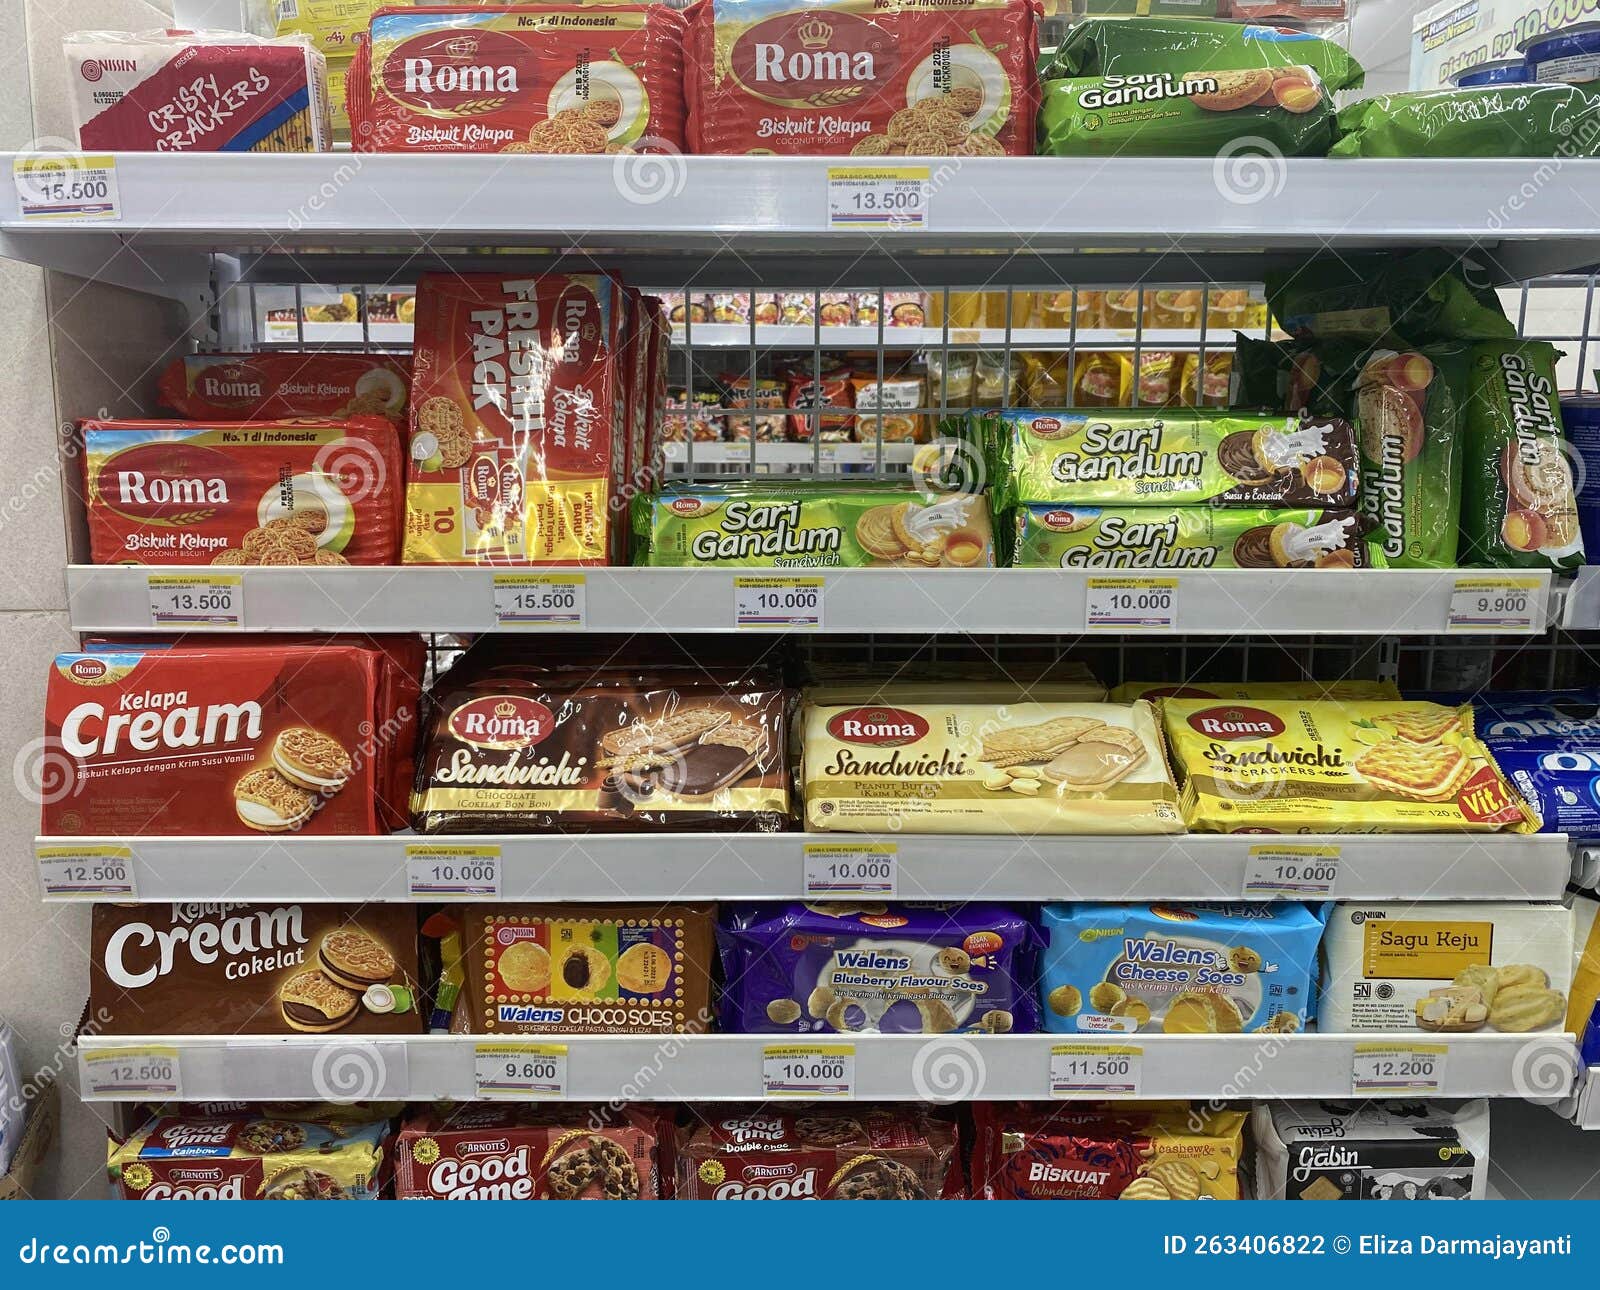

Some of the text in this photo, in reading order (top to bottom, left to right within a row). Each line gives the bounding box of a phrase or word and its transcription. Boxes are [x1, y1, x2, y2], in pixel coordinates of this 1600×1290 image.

[548, 16, 559, 26] di
[560, 16, 617, 27] Indonesia
[99, 59, 137, 72] NISSIN
[755, 43, 876, 82] Roma
[933, 42, 942, 89] FEB 2023
[1439, 32, 1513, 84] Diskon Rp
[405, 58, 519, 93] Roma
[1078, 77, 1218, 109] Gandum
[156, 67, 270, 151] CRACKERS
[406, 125, 514, 144] Biskuit Kelapa
[757, 117, 872, 138] Biskuit Kelapa
[775, 136, 846, 146] COCONUT BISCUIT
[41, 182, 108, 200] 15.500
[853, 192, 919, 209] 13.500
[564, 301, 586, 363] Roma
[470, 309, 508, 411] PACK
[502, 279, 546, 431] FRESH
[204, 378, 350, 397] Roma Biskuit Kelapa
[550, 385, 573, 447] Kelapa
[1501, 353, 1541, 466] Gandum
[1528, 372, 1561, 445] Sari
[1035, 422, 1058, 430] Roma
[222, 432, 317, 442] No. 1 di Indonesia
[1080, 421, 1164, 454] Sari
[1288, 440, 1303, 449] milk
[1051, 442, 1203, 483] Gandum
[117, 471, 230, 504] Roma
[477, 465, 489, 500] Roma
[1135, 478, 1203, 494] Sandwich
[1224, 490, 1282, 500] Susu Cokelat
[1382, 435, 1405, 559] Gandum
[676, 501, 698, 509] Roma
[434, 506, 455, 533] 10
[573, 503, 582, 537] BARU!
[720, 500, 802, 533] Sari
[928, 513, 943, 521] milk
[1048, 514, 1071, 523] Roma
[692, 520, 842, 560] Gandum
[1093, 515, 1178, 549] Sari
[1308, 535, 1323, 544] milk
[125, 534, 228, 551] Biskuit Kelapa
[774, 552, 841, 567] Sandwich
[1060, 537, 1219, 568] Gandum
[172, 594, 231, 609] 13.500
[514, 594, 574, 608] 15.500
[758, 594, 817, 608] 10.000
[1110, 595, 1171, 609] 10.000
[1477, 598, 1526, 612] 9.900
[75, 664, 103, 675] Roma
[120, 691, 188, 713] Kelapa
[60, 700, 263, 758] Cream
[465, 713, 540, 737] Roma
[843, 720, 917, 737] Roma
[1201, 718, 1273, 734] Roma
[825, 749, 968, 777] Sandwichi
[1203, 742, 1346, 768] Sandwichi
[77, 754, 255, 780] Biskuit Kelapa dengan Krim Susu Vanilla
[438, 750, 584, 786] Sandwichi
[1241, 767, 1315, 777] CRACKERS
[854, 781, 897, 791] PEANUT
[476, 790, 537, 800] CHOCOLATE
[457, 800, 551, 809] (COKELAT BON BON)
[1428, 809, 1461, 820] 120 g
[63, 867, 126, 881] 12.500
[432, 866, 494, 880] 10.000
[828, 864, 890, 879] 10.000
[1275, 866, 1336, 881] 10.000
[512, 928, 534, 938] NISSIN
[1380, 931, 1479, 950] Sagu Keju
[105, 905, 309, 989] Cream
[1124, 939, 1215, 965] Walens
[225, 947, 305, 980] Cokelat
[838, 952, 910, 969] Walens
[833, 973, 984, 992] Blueberry Flavour Soes
[1116, 963, 1245, 985] Cheese Soes
[499, 1006, 673, 1026] Walens CHOCO SOES
[111, 1066, 172, 1080] 12.500
[505, 1064, 556, 1079] 9.600
[783, 1064, 844, 1078] 10.000
[1069, 1061, 1129, 1075] 11.500
[1372, 1062, 1434, 1076] 12.200
[162, 1122, 233, 1139] Good
[721, 1118, 783, 1131] Good
[168, 1132, 227, 1148] Time
[731, 1127, 785, 1142] Time
[171, 1147, 218, 1156] Rainbow
[467, 1142, 506, 1152] ARNOTT'S
[726, 1141, 762, 1153] Double
[180, 1170, 220, 1180] ARNOTT'S
[431, 1148, 530, 1193] Good
[754, 1166, 793, 1176] ARNOTT'S
[714, 1171, 814, 1200] Good
